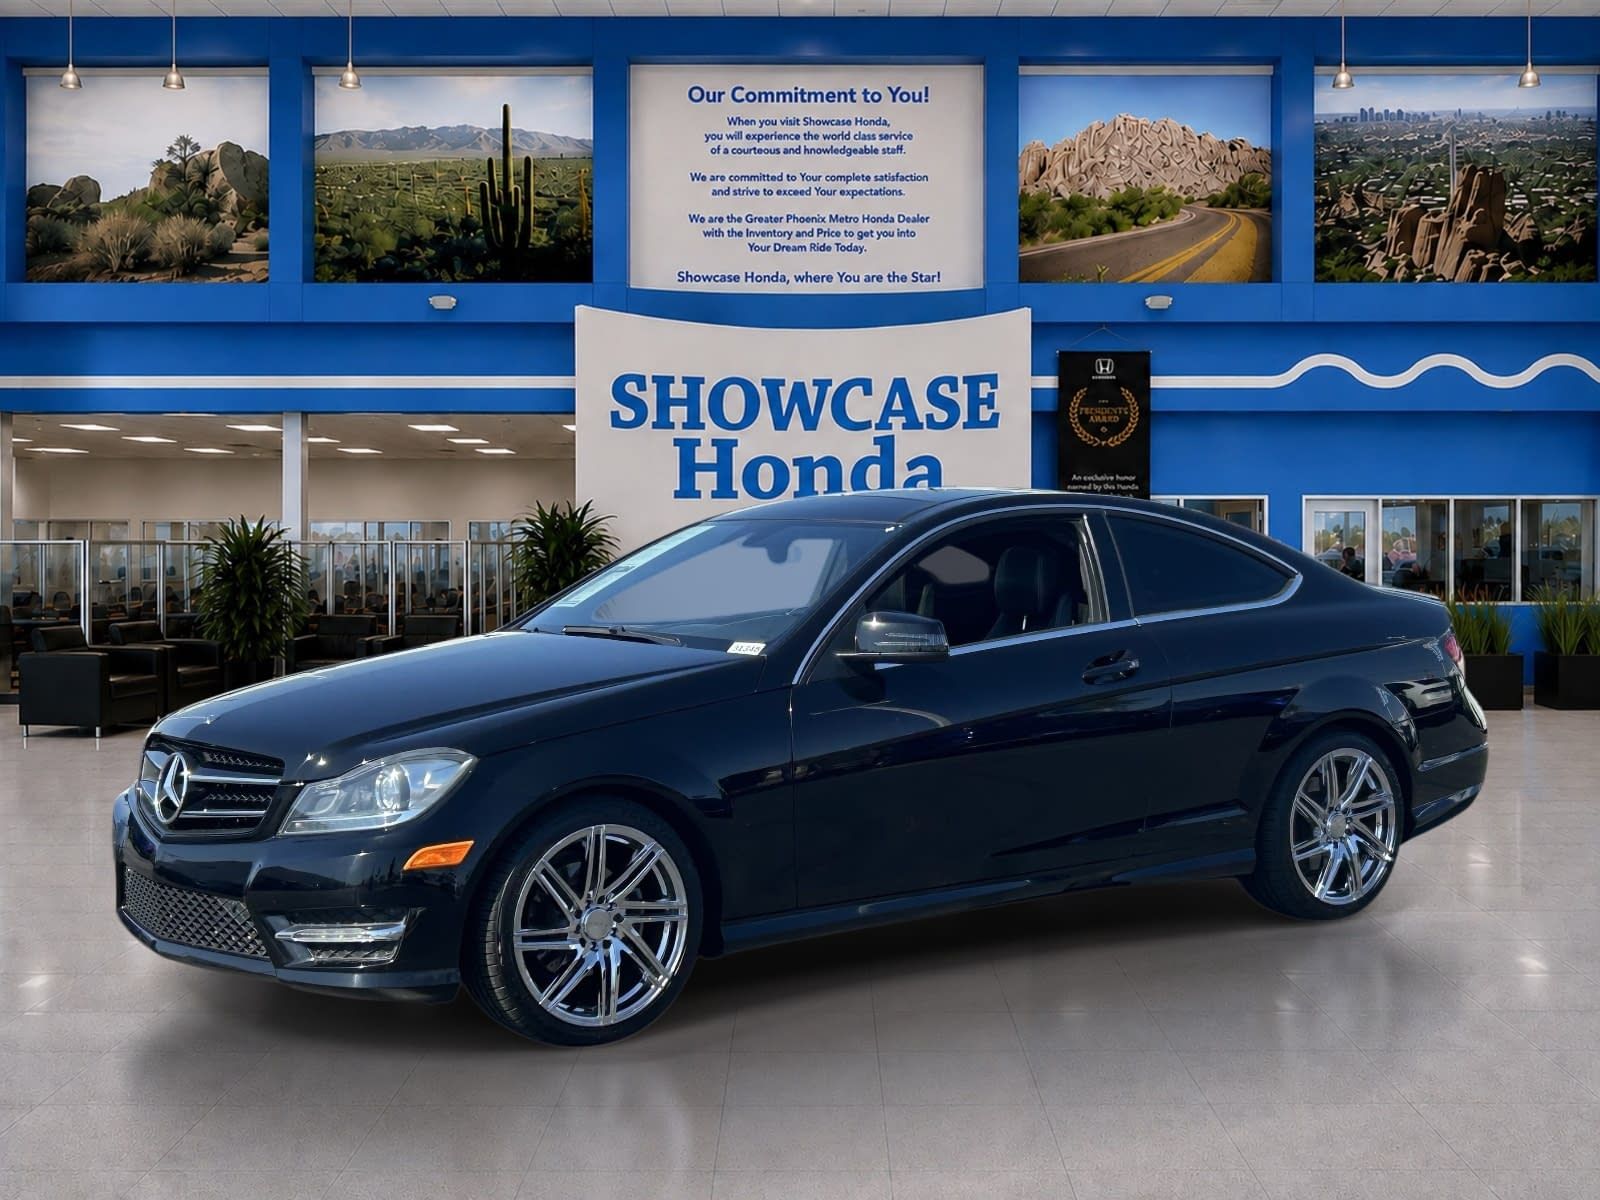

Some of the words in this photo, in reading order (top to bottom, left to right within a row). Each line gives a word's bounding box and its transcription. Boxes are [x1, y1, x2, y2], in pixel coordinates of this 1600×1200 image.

[687, 85, 726, 104] Our
[730, 85, 857, 104] Commitment
[861, 87, 883, 104] to
[886, 85, 929, 104] You!
[726, 117, 757, 127] When
[758, 119, 778, 129] you
[779, 117, 801, 127] visit
[802, 117, 853, 127] Showcase
[854, 117, 891, 128] Honda,
[704, 133, 724, 143] you
[724, 131, 743, 141] will
[744, 131, 801, 143] experience
[802, 131, 820, 141] the
[821, 131, 851, 141] world
[853, 131, 877, 141] class
[878, 131, 914, 142] service
[709, 145, 722, 155] of
[730, 147, 782, 156] courteous
[782, 145, 802, 155] and
[881, 145, 907, 155] staff.
[689, 173, 708, 183] We
[709, 175, 727, 183] are
[728, 172, 784, 183] committed
[785, 174, 798, 183] to
[799, 173, 823, 183] Your
[824, 172, 872, 185] complete
[873, 172, 929, 183] satisfaction
[711, 186, 731, 197] and
[732, 187, 761, 197] strive
[762, 188, 774, 197] to
[775, 187, 812, 197] exceed
[813, 187, 838, 197] Your
[838, 187, 906, 200] expectations.
[688, 214, 706, 224] We
[707, 216, 725, 224] are
[725, 214, 743, 224] the
[744, 214, 785, 224] Greater
[785, 214, 827, 224] Phoenix
[828, 214, 860, 224] Metro
[861, 214, 895, 224] Honda
[897, 214, 931, 224] Dealer
[702, 228, 725, 238] with
[726, 228, 744, 238] the
[745, 228, 794, 241] Inventory
[794, 228, 815, 239] and
[816, 228, 842, 238] Price
[843, 230, 855, 238] to
[856, 230, 875, 241] get
[875, 231, 895, 241] you
[896, 228, 917, 238] into
[747, 243, 772, 253] Your
[772, 243, 808, 253] Dream
[809, 243, 833, 253] Ride
[833, 243, 868, 255] Today.
[676, 270, 741, 284] Showcase
[744, 270, 790, 286] Honda,
[793, 270, 835, 284] where
[835, 270, 861, 284] You
[863, 273, 885, 284] are
[886, 270, 908, 284] the
[910, 270, 942, 284] Star!
[610, 373, 1000, 431] SHOWCASE
[673, 434, 943, 500] Honda
